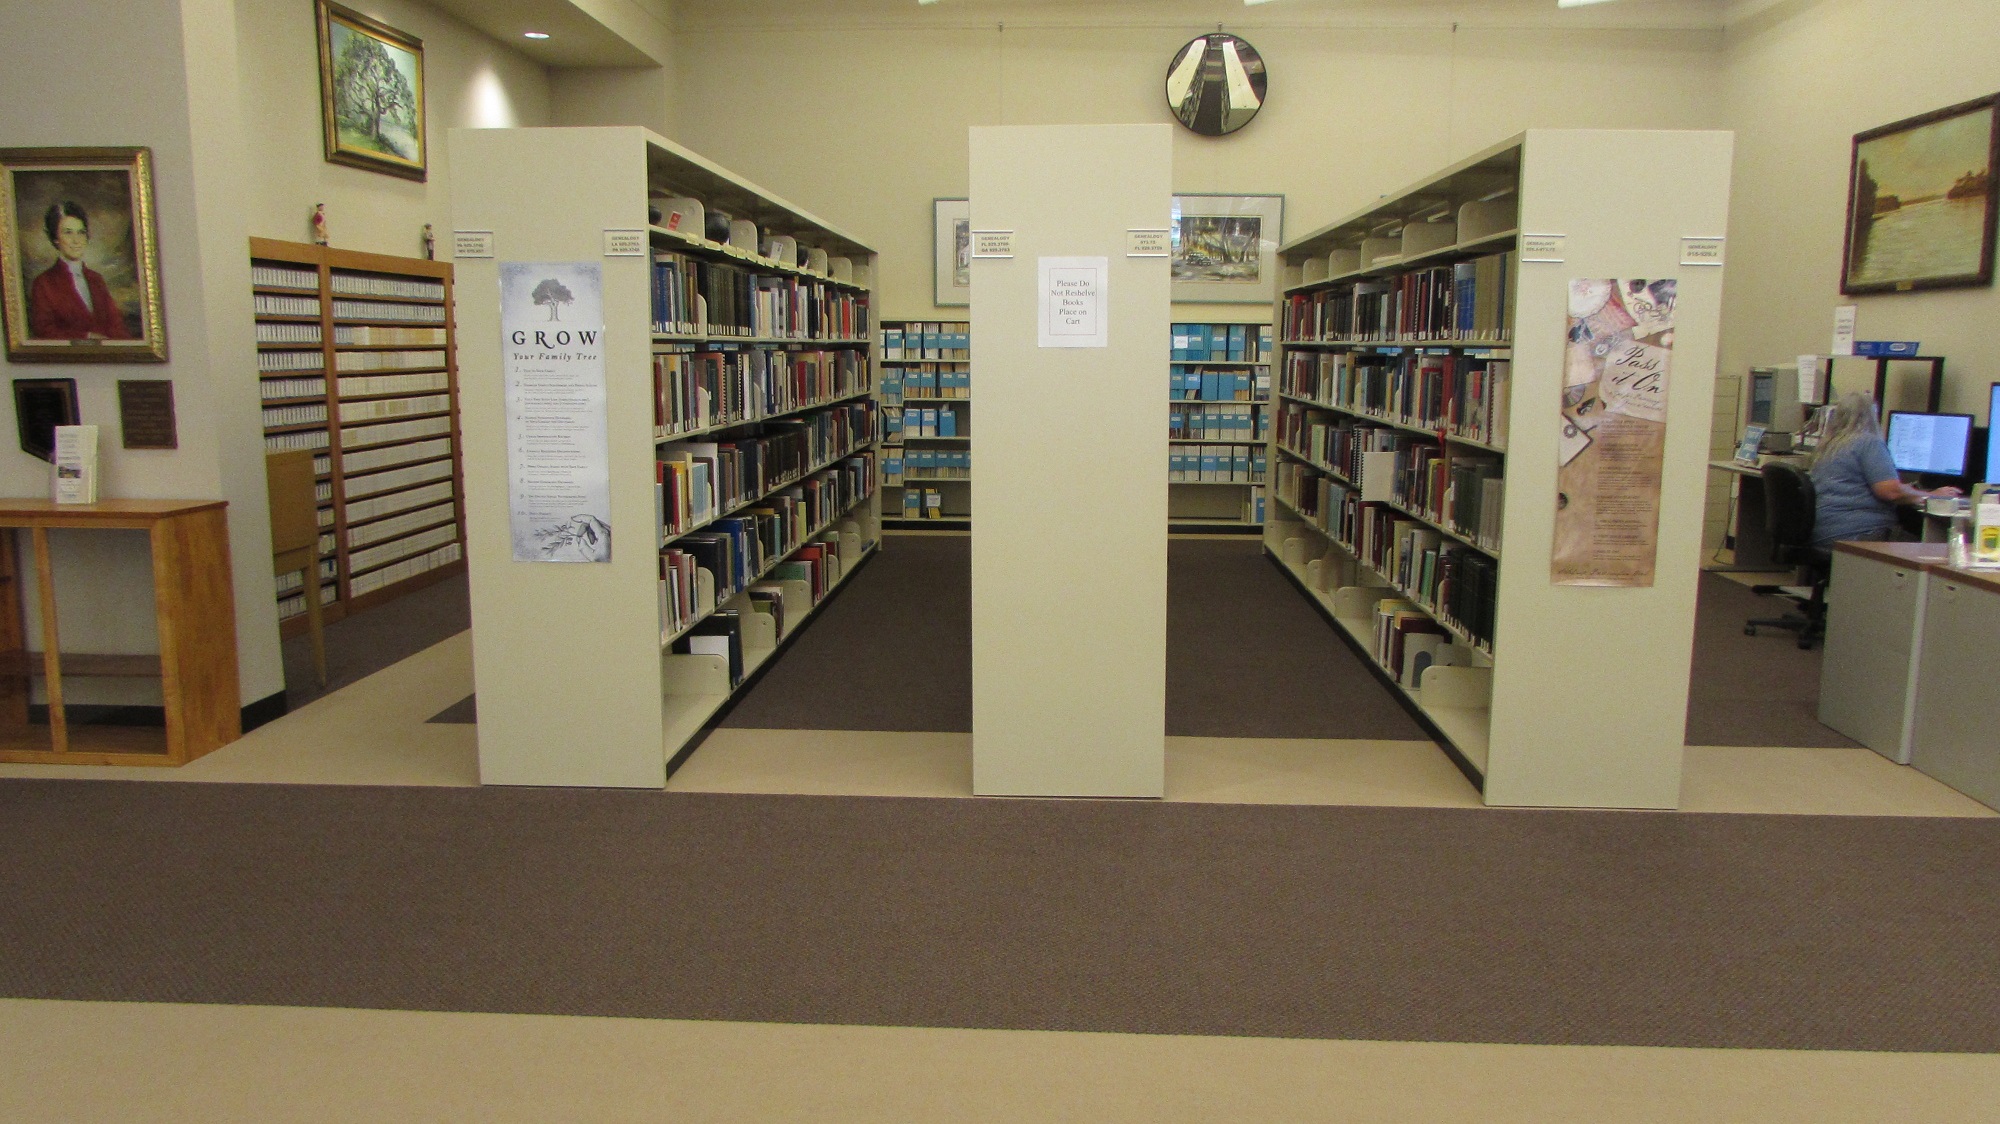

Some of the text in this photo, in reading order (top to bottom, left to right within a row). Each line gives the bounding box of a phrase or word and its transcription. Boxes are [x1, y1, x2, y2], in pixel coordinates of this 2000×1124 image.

[1056, 280, 1090, 288] Please Do
[1065, 289, 1096, 297] Reshelve
[1059, 308, 1077, 316] Place
[512, 330, 598, 349] GROW
[513, 353, 598, 363] Your Family Tree
[1616, 345, 1660, 371] Pass
[1612, 370, 1665, 394] it On
